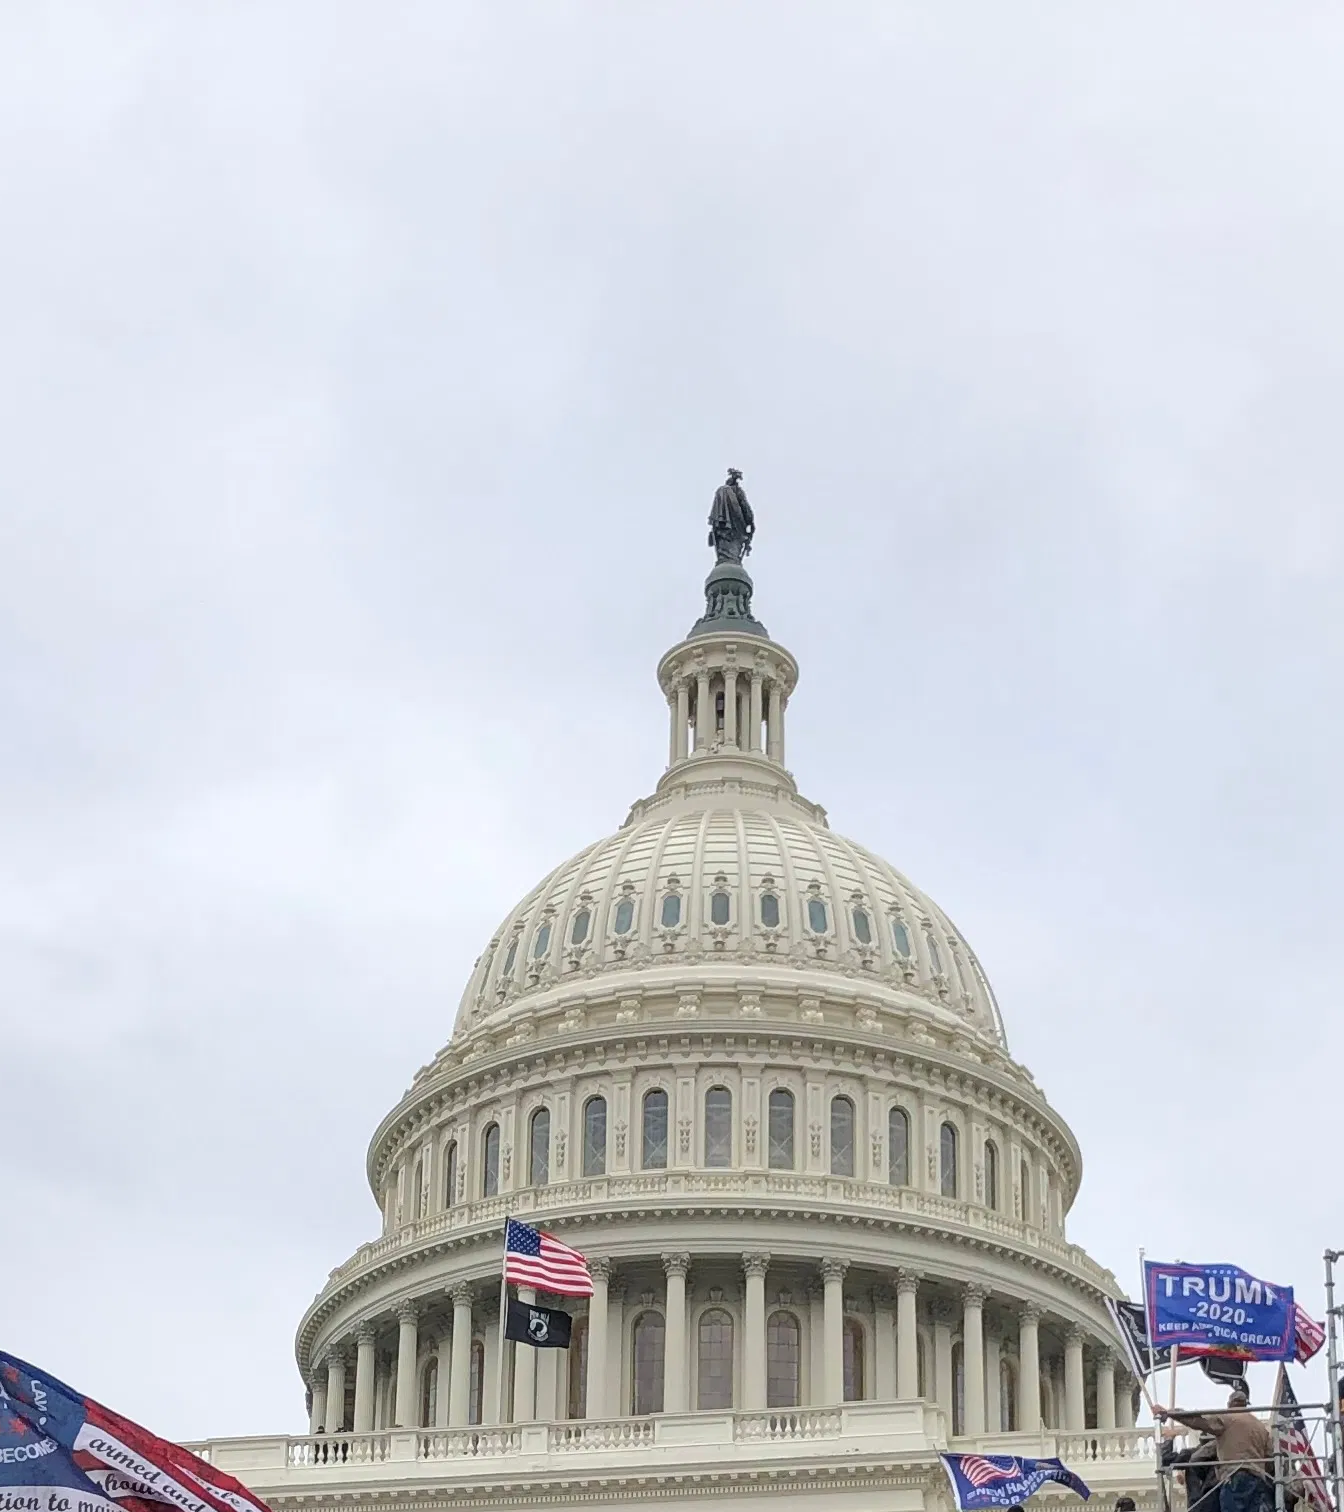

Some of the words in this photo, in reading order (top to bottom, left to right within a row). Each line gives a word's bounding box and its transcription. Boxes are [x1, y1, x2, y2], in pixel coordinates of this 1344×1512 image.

[1189, 1302, 1254, 1326] -2020-
[1159, 1322, 1189, 1332] KEEP
[1240, 1332, 1281, 1347] GREAT!
[89, 1437, 161, 1485] armed
[48, 1493, 72, 1512] to
